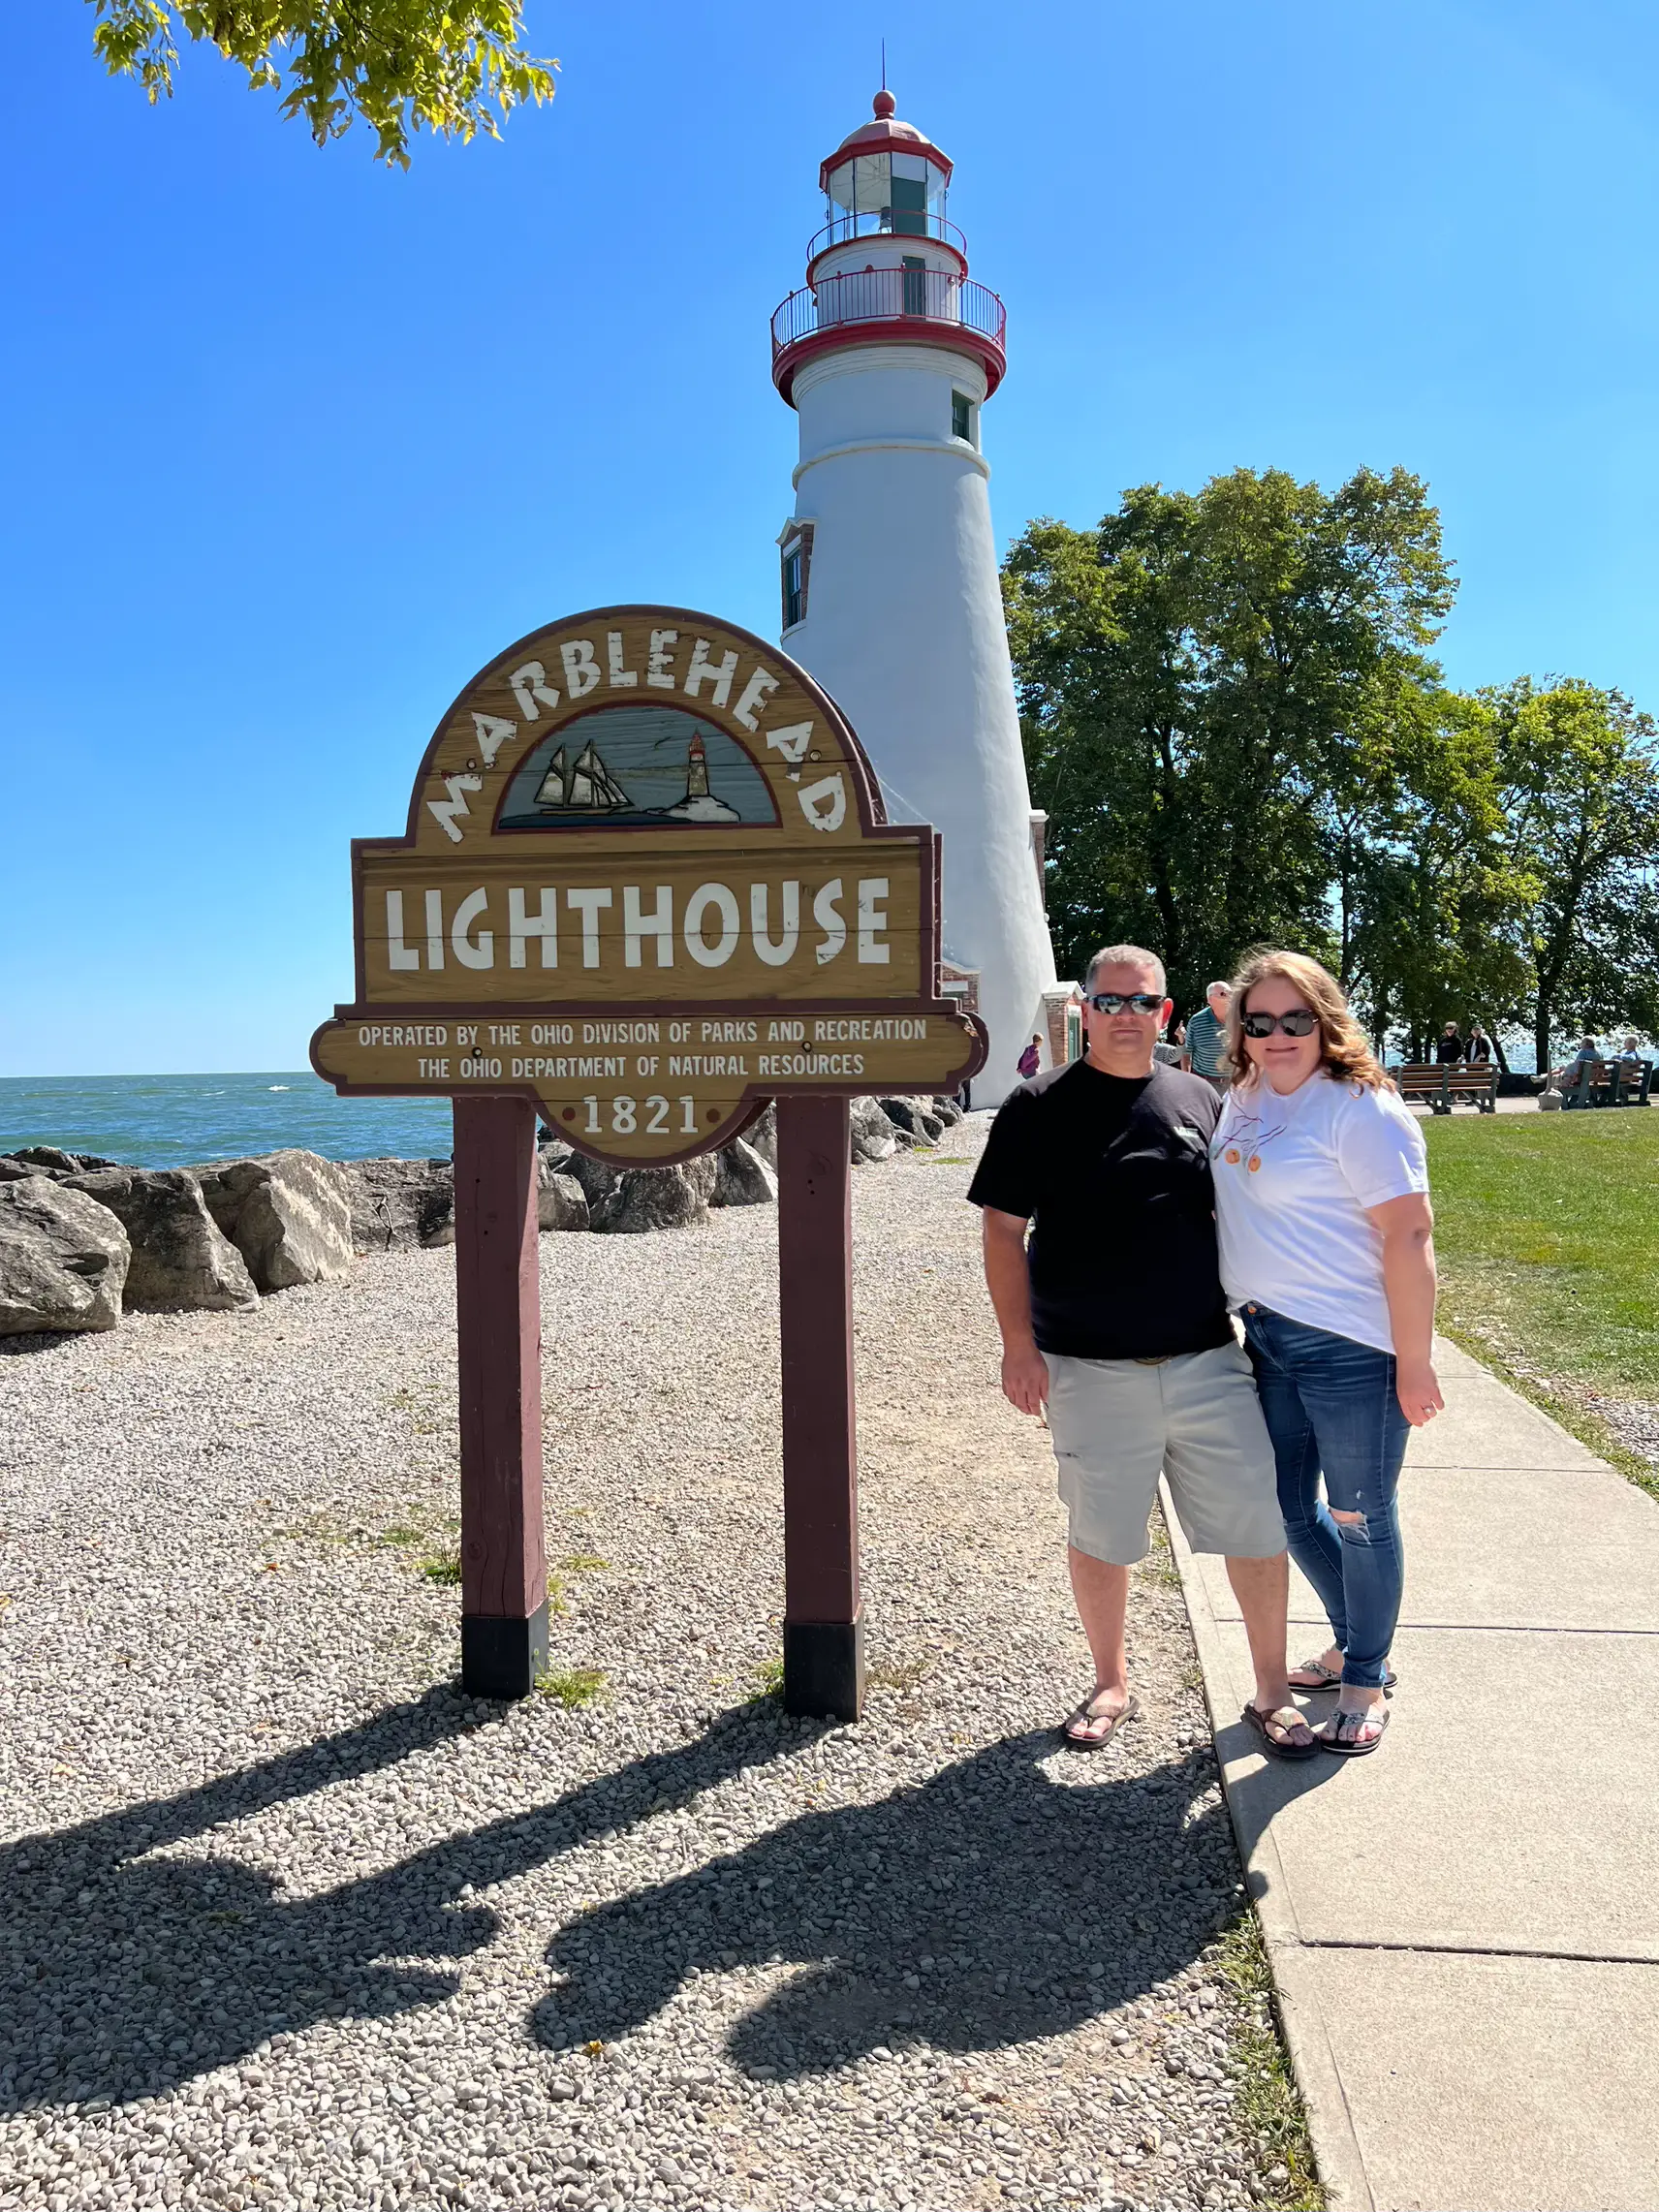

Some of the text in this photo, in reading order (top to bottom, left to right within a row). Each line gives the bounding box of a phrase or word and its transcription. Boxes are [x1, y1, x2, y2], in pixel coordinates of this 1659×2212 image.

[425, 628, 845, 843] MARBLEHEAD
[386, 877, 891, 971] LIGHTHOUSE
[359, 1019, 926, 1046] OPERATED BY THE OHIO DIVISION OF PARKS AND RECREATION
[418, 1054, 864, 1078] THE OHIO DEPARTMENT OF NATURAL RESOURCES
[583, 1095, 699, 1134] 1821
